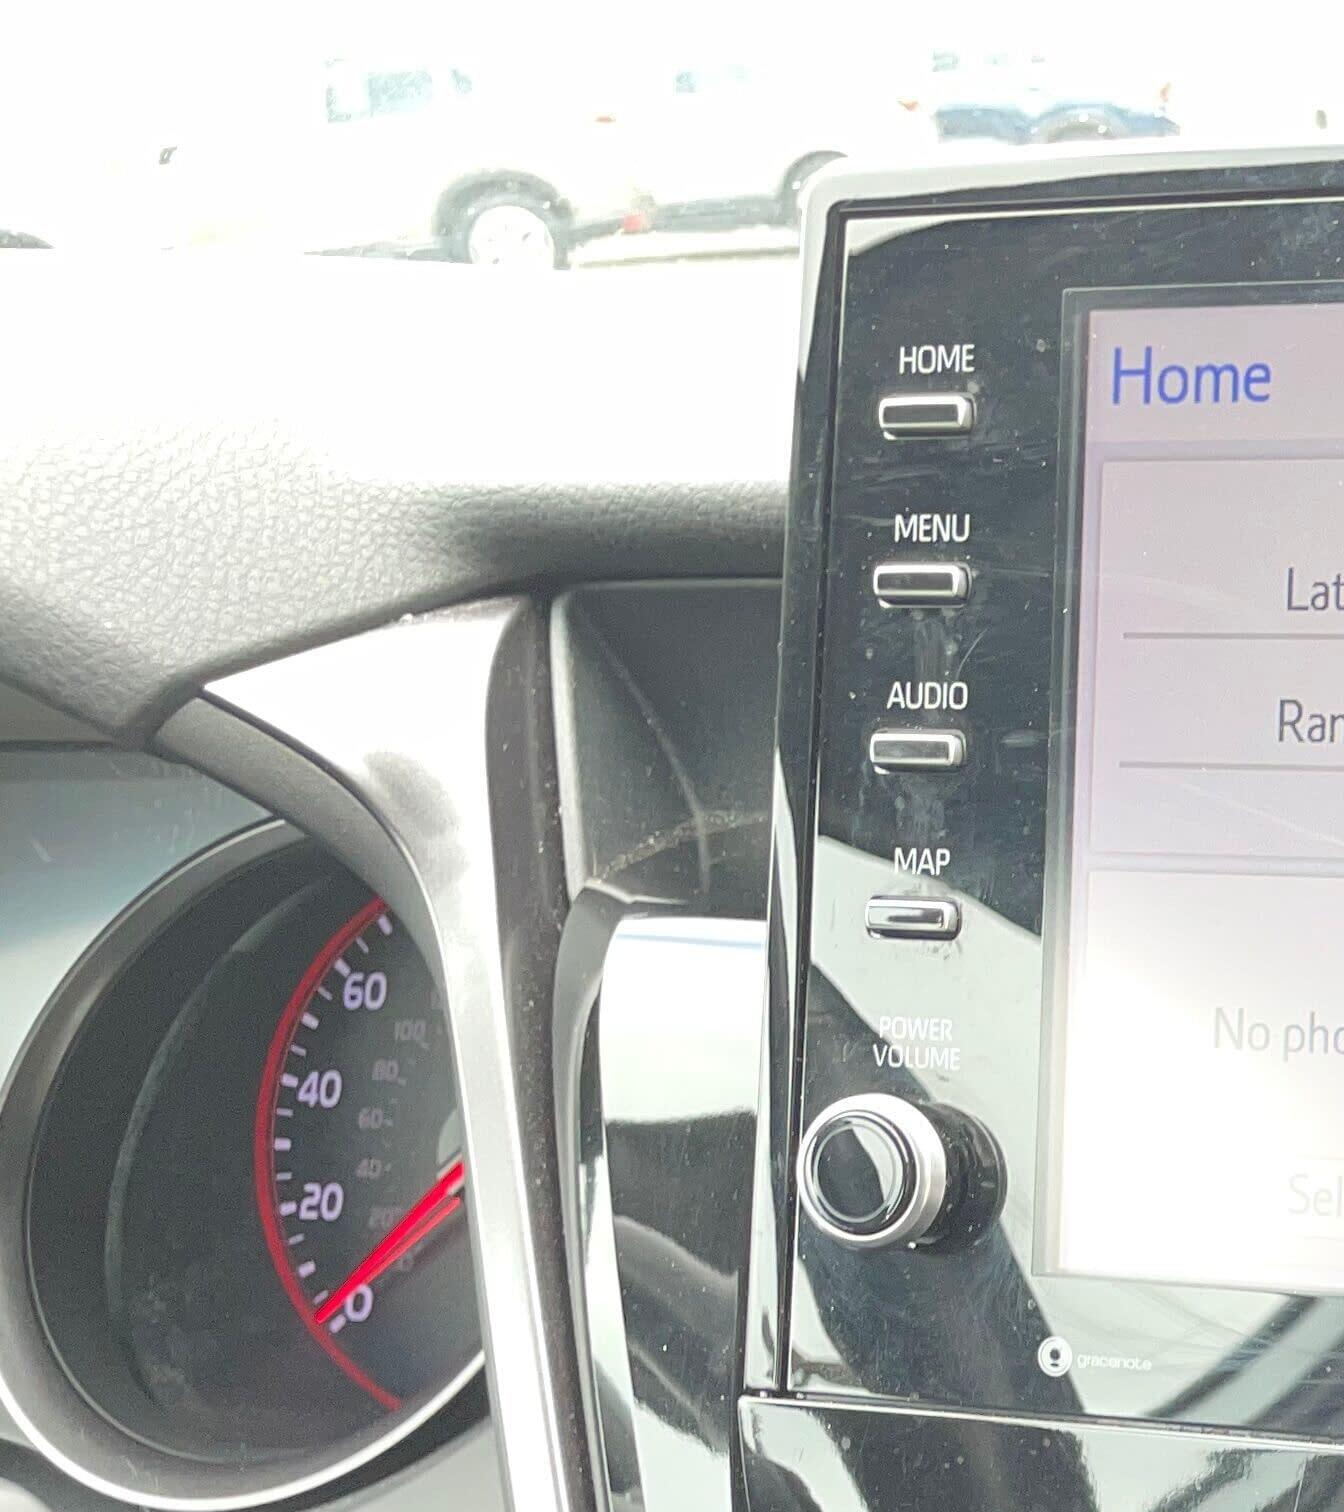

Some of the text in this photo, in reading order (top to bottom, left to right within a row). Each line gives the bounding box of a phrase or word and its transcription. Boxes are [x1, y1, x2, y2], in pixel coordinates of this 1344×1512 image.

[899, 345, 975, 374] HOME
[1111, 346, 1272, 405] Home
[894, 514, 970, 543] MENU
[887, 681, 968, 709] AUDIO
[894, 847, 950, 876] MAP
[343, 972, 387, 1011] 60
[878, 1016, 954, 1042] POWER
[1213, 1006, 1270, 1053] No
[872, 1044, 961, 1071] VOLUME
[298, 1069, 342, 1109] 40
[300, 1182, 343, 1222] 20
[343, 1284, 373, 1322] 0
